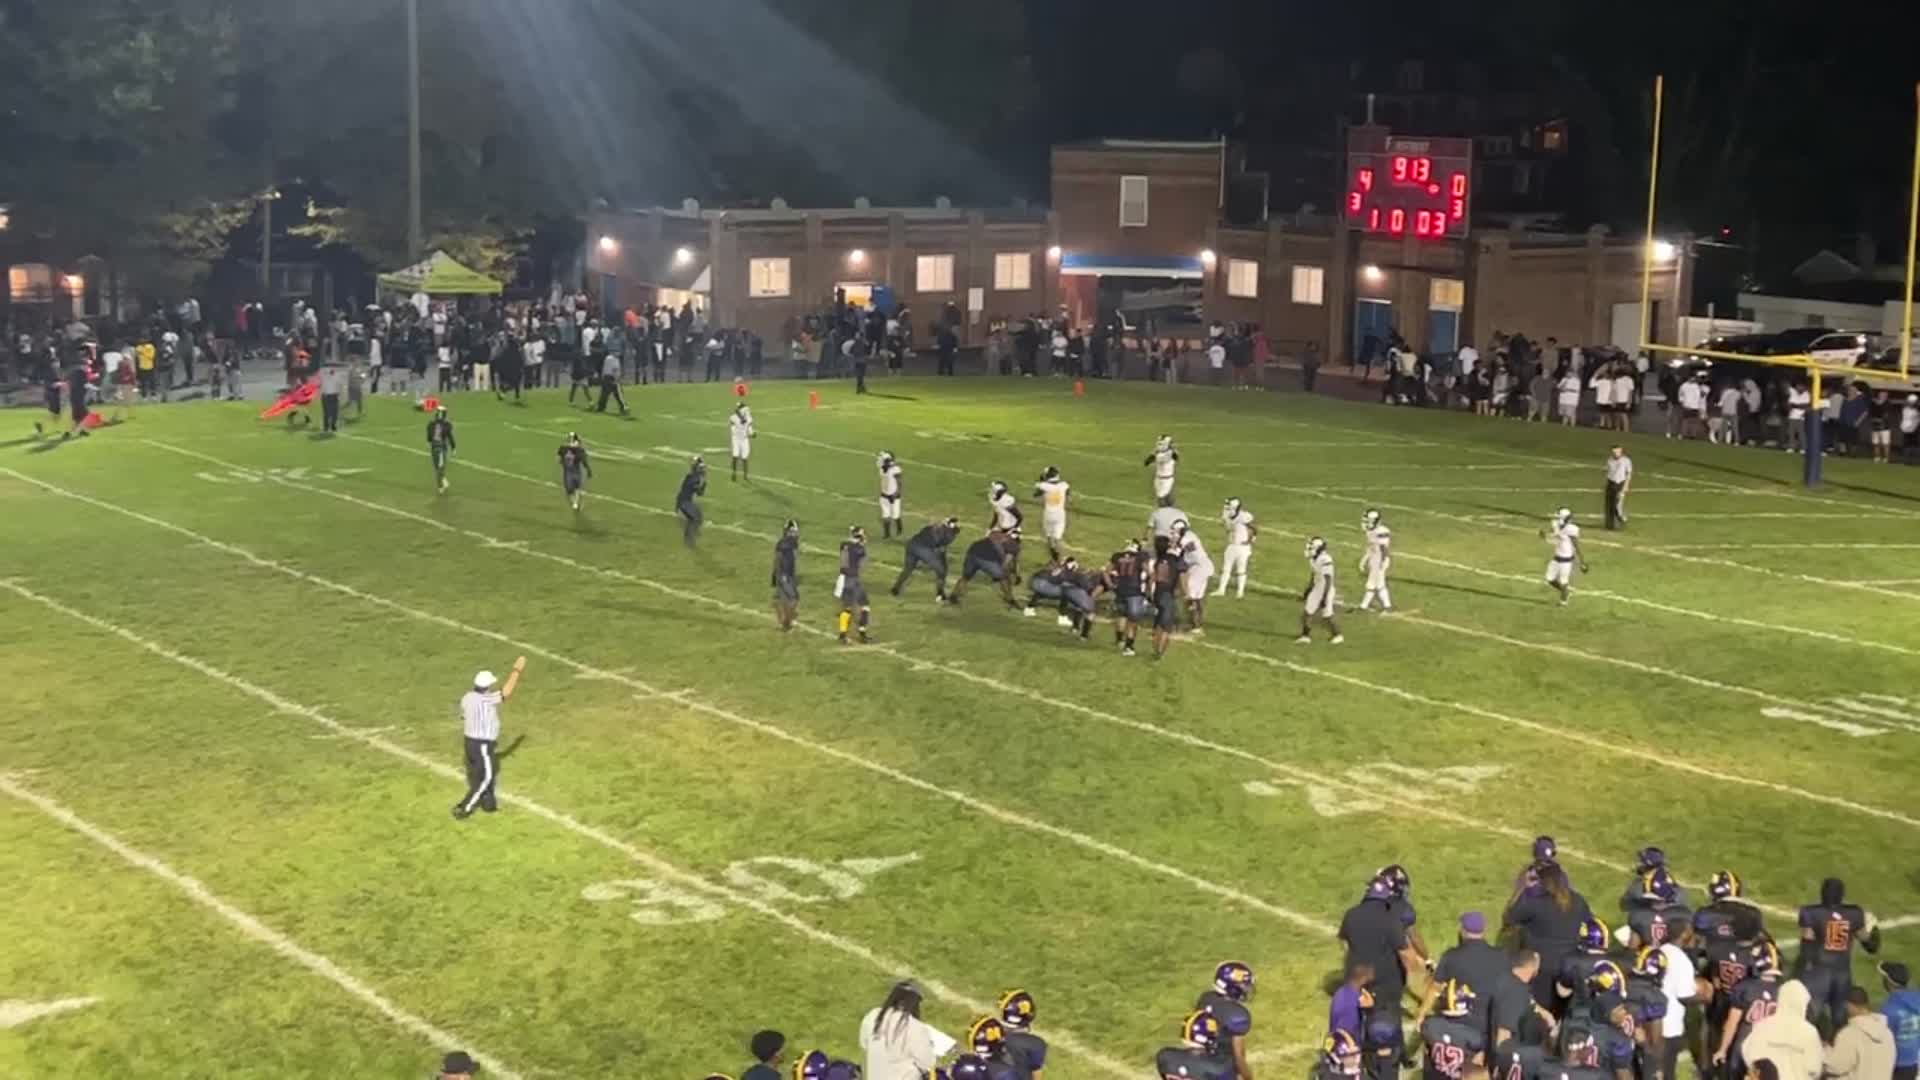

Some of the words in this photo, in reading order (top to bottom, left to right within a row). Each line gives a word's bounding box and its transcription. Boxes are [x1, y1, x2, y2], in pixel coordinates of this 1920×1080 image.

[1360, 169, 1372, 191] 4
[1452, 174, 1466, 197] 0
[1350, 192, 1361, 211] 3
[1452, 199, 1463, 218] 3
[1417, 210, 1446, 235] 03
[1825, 920, 1849, 950] 15
